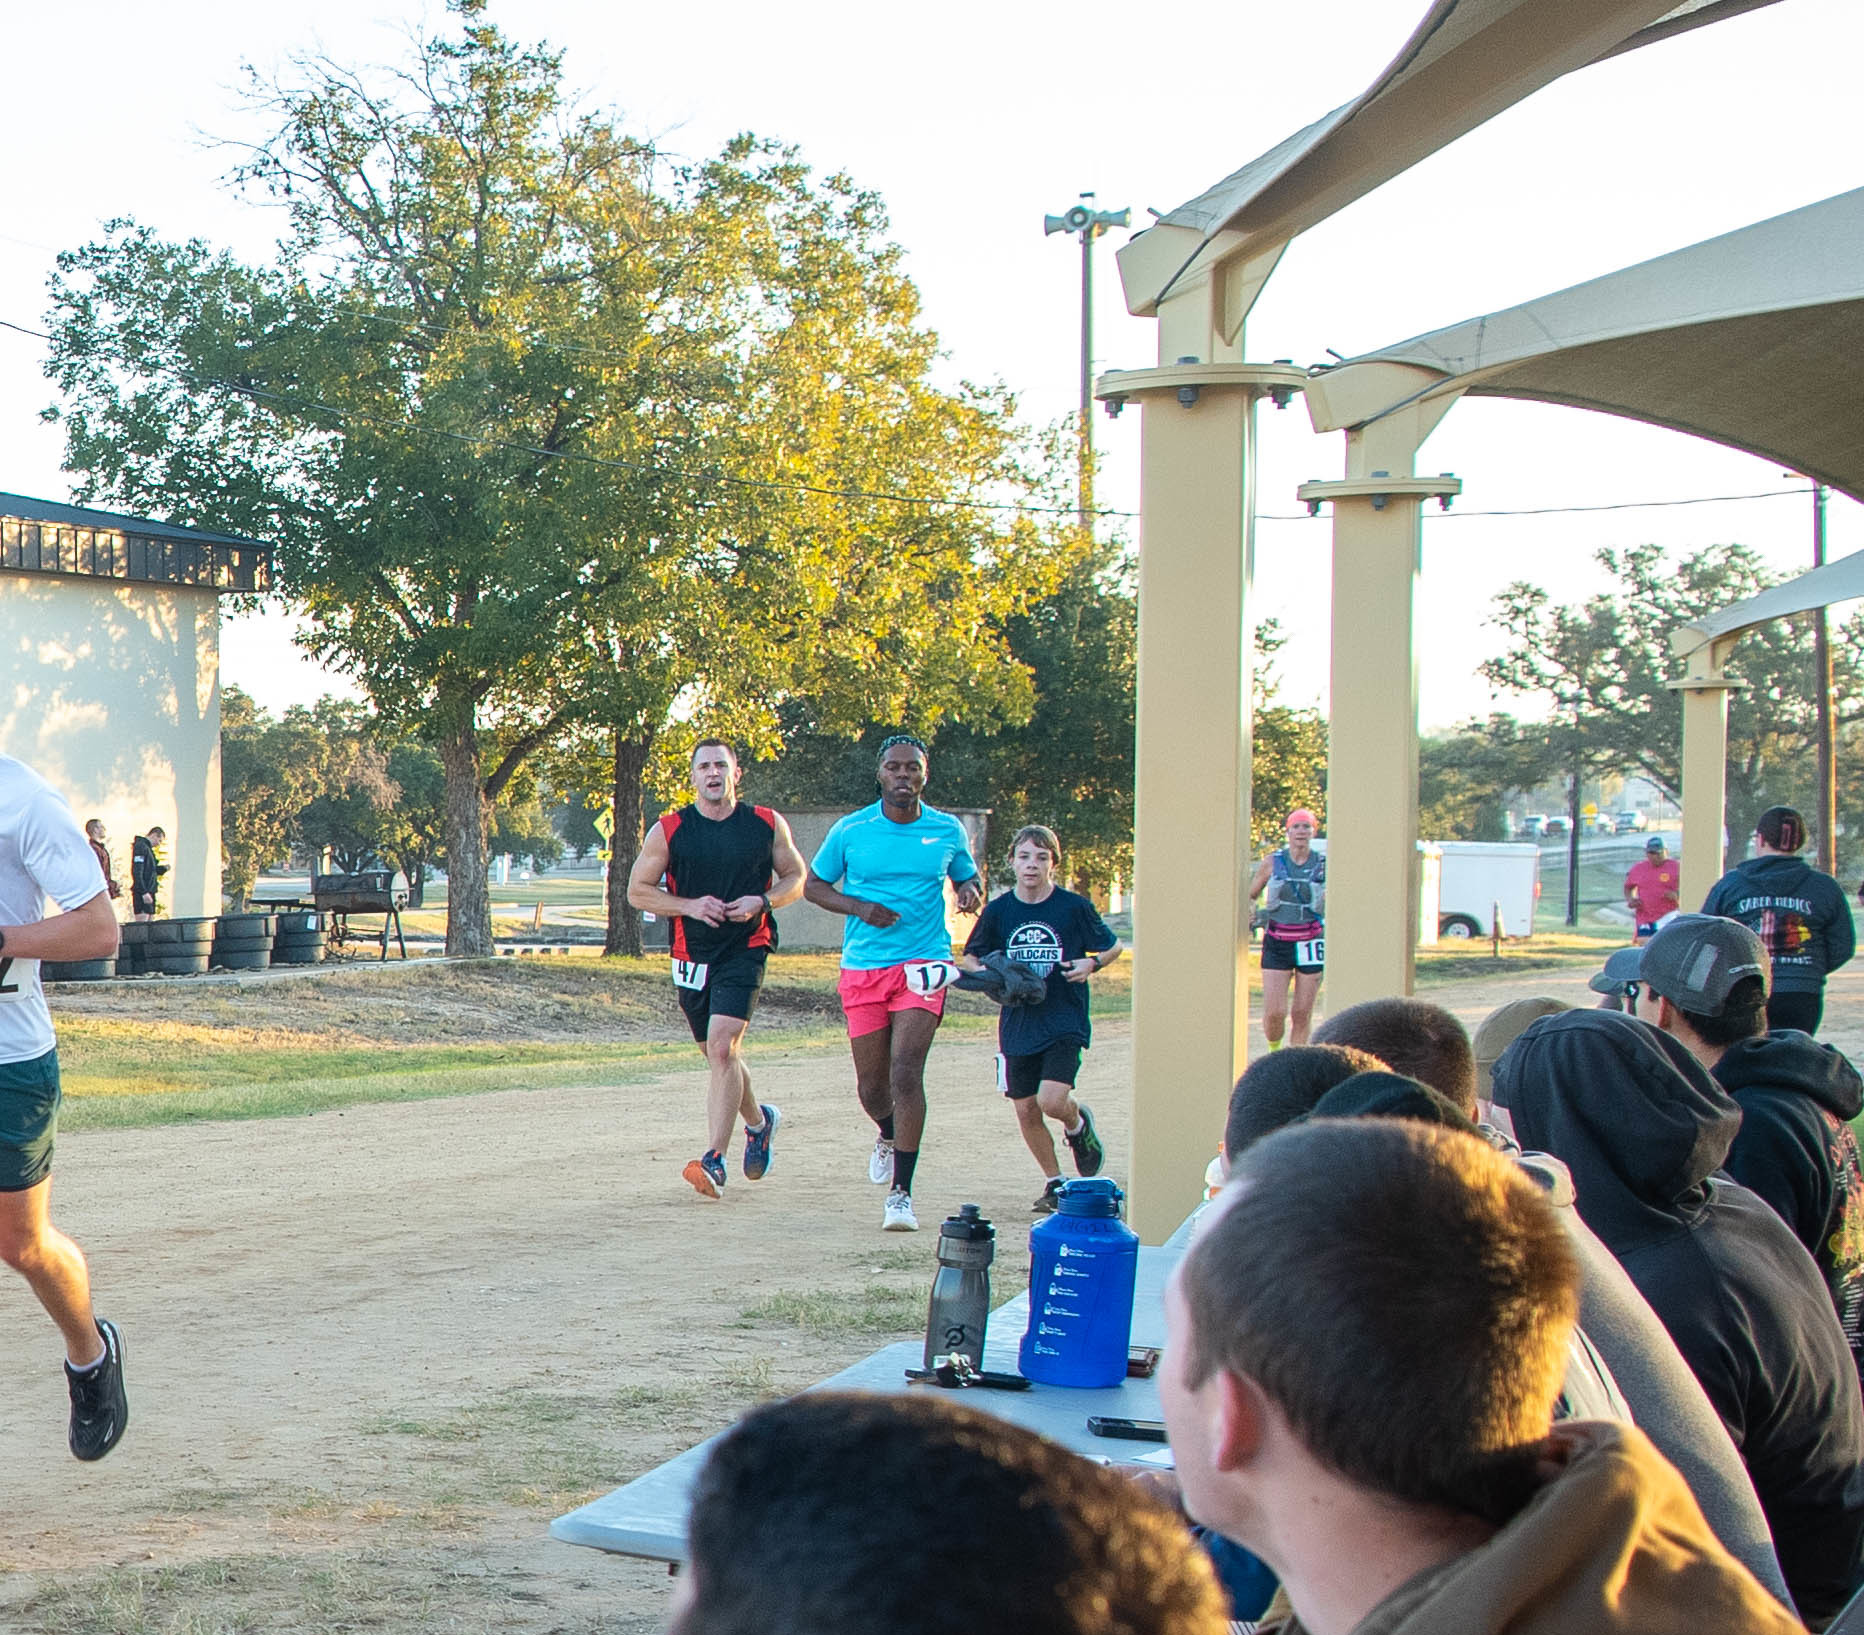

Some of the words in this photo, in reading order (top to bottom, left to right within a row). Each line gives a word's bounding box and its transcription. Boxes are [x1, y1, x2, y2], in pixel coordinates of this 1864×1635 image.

[1010, 949, 1058, 960] WILDCATS
[1304, 942, 1325, 961] 16
[917, 964, 947, 991] 17
